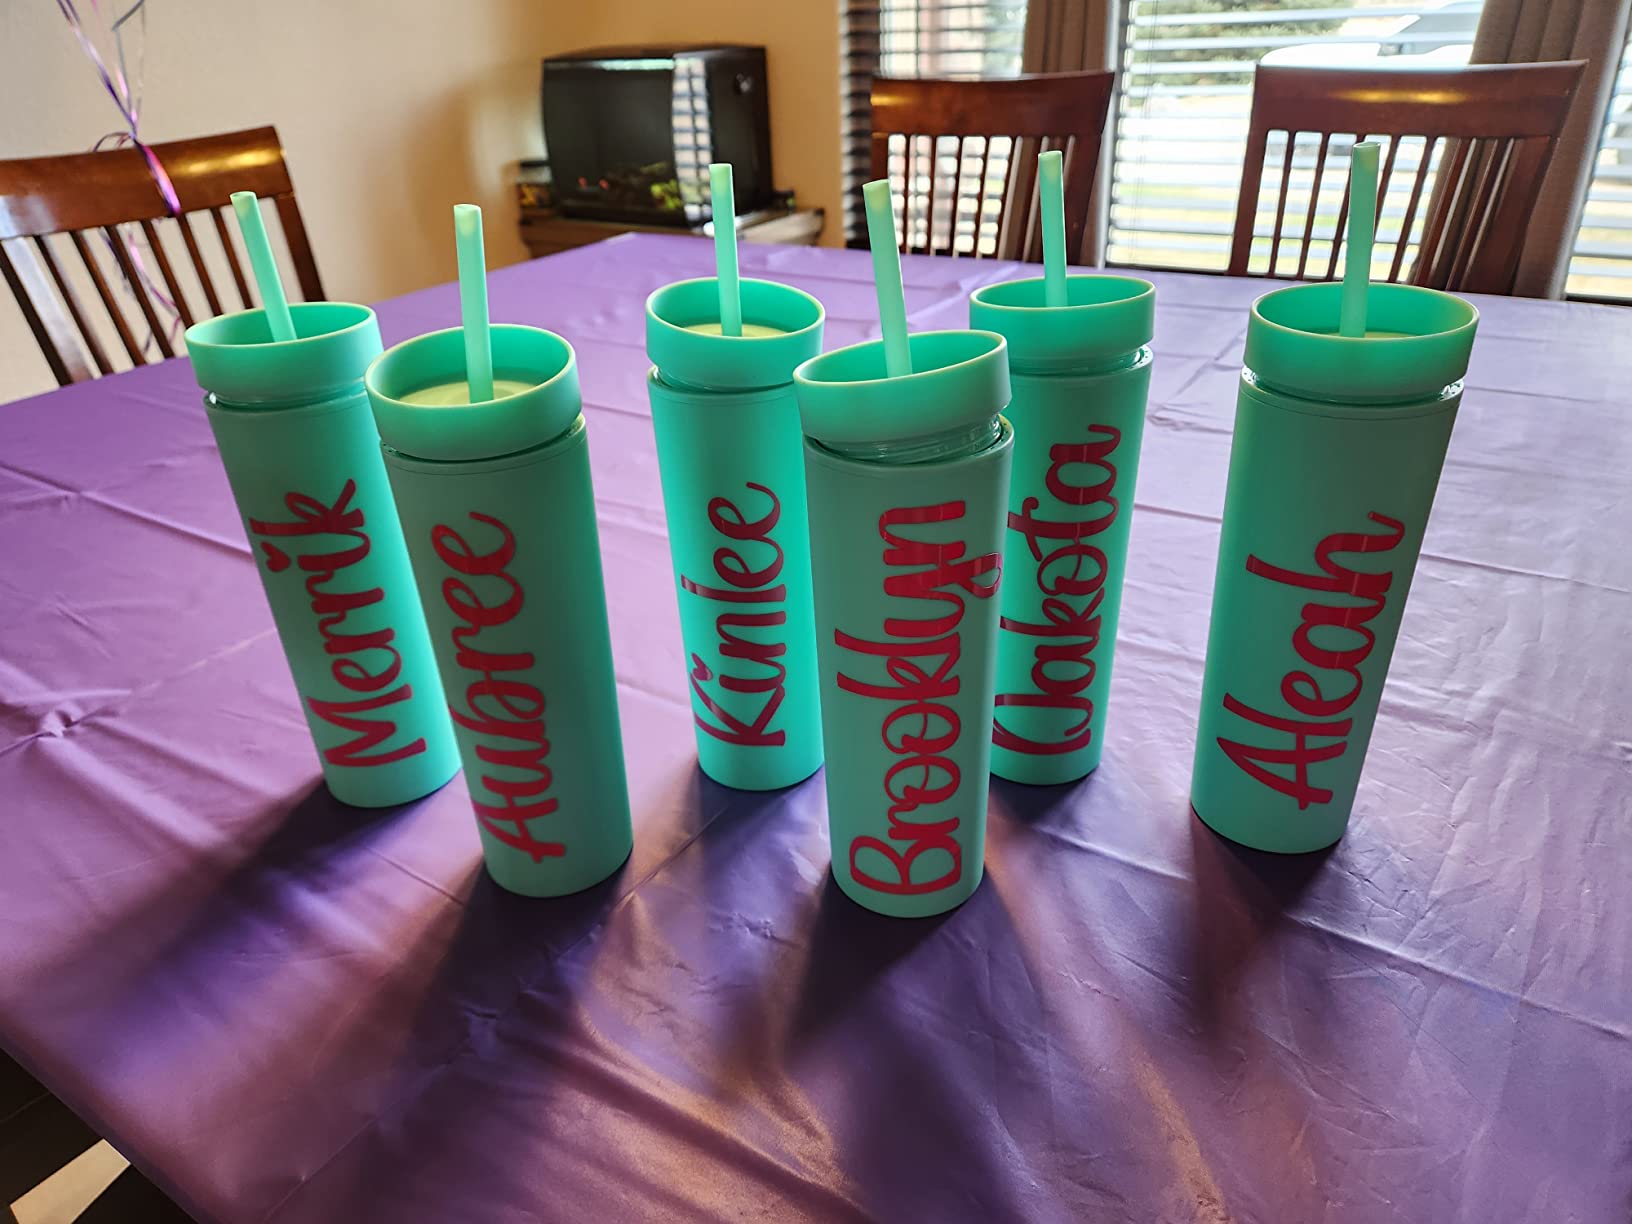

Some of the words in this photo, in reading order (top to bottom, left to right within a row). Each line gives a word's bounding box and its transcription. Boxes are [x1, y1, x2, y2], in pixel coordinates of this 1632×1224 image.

[249, 478, 427, 767] Merrik
[431, 511, 566, 864] Aubree
[681, 482, 785, 747] Kinlee
[834, 500, 1002, 895] Brooklyn
[992, 424, 1121, 755] Dakota
[1216, 511, 1405, 810] Aleah
